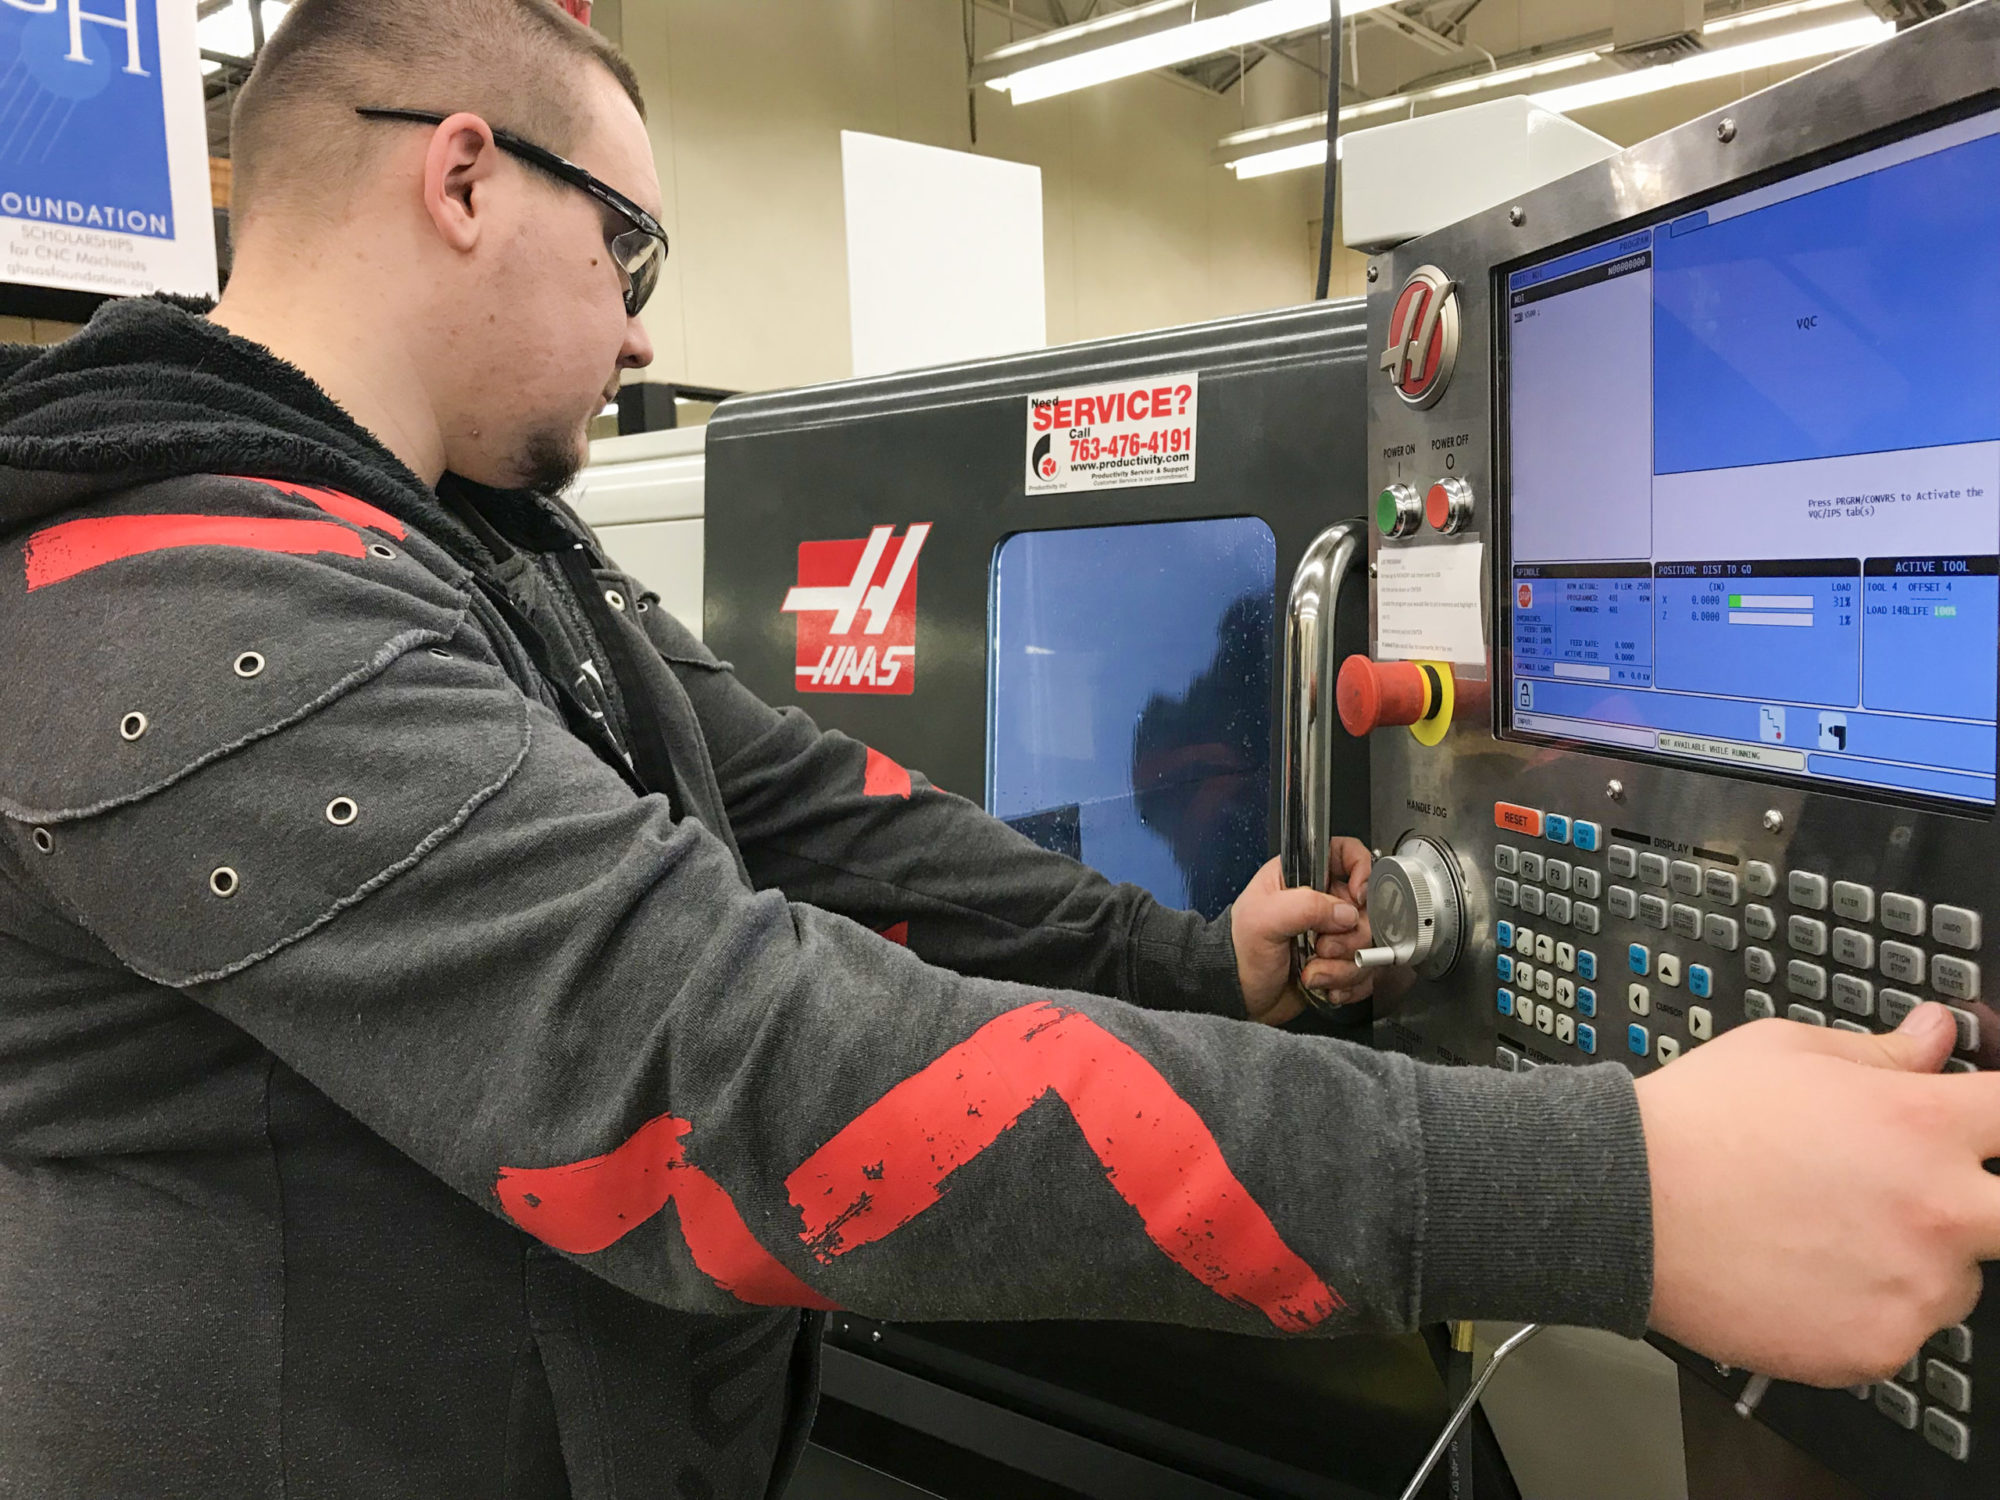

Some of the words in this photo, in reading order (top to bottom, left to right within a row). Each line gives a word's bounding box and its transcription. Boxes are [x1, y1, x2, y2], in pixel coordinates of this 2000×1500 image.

[1, 192, 167, 235] OUNDATION
[21, 225, 134, 252] SCHOLARSHIPS
[10, 241, 29, 256] for
[34, 244, 70, 261] CNC
[76, 252, 146, 272] Machinists
[1796, 315, 1818, 330] VQC
[1031, 396, 1059, 409] Need
[1033, 384, 1192, 431] SERVICE?
[1069, 427, 1090, 440] Call
[1070, 427, 1191, 462] 763-476-4191
[1431, 437, 1454, 450] POWER
[1456, 434, 1469, 446] OFF
[1383, 446, 1404, 459] POWER
[1405, 443, 1416, 455] ON
[1070, 452, 1190, 472] www.productivity.com
[1091, 471, 1128, 480] Productivity
[1130, 469, 1154, 477] Service
[1163, 465, 1190, 475] Support
[1808, 499, 1831, 508] Press
[1836, 494, 1895, 506] PRGRM/CONVRS
[1901, 493, 1911, 502] to
[1916, 489, 1960, 501] Activate
[1966, 487, 1984, 497] the
[1808, 508, 1841, 520] VQC/IPS
[1846, 506, 1875, 517] tab(s)
[1516, 568, 1540, 577] SPINDLE
[1658, 565, 1697, 575] POSITION:
[1703, 565, 1721, 574] DIST
[1727, 565, 1737, 574] TO
[1741, 565, 1752, 574] GO
[1895, 561, 1936, 573] ACTIVE
[1942, 560, 1970, 572] TOOL
[1708, 582, 1725, 593] (IN)
[1831, 583, 1851, 592] LOAD
[1867, 583, 1887, 592] TOOL
[1892, 582, 1897, 591] 4
[1908, 583, 1940, 592] OFFSET
[1946, 582, 1952, 592] 4
[1691, 595, 1720, 606] 0.0000
[1662, 611, 1667, 620] Z
[1866, 606, 1887, 615] LOAD
[1614, 641, 1635, 650] 0.0000
[795, 645, 916, 686] HAAS
[1660, 737, 1671, 748] NOT
[1674, 739, 1706, 752] AVAILABLE
[1709, 744, 1728, 756] WHILE
[1731, 747, 1760, 760] RUNNING
[1407, 799, 1431, 815] HANDLE
[1433, 806, 1447, 818] JOG
[1504, 812, 1528, 827] RESET
[1654, 837, 1689, 855] DISPLAY
[1499, 853, 1508, 866] F1
[1524, 861, 1534, 873] F2
[1550, 868, 1560, 881] F3
[1578, 876, 1588, 889] F4
[1656, 1002, 1684, 1018] CURSOR
